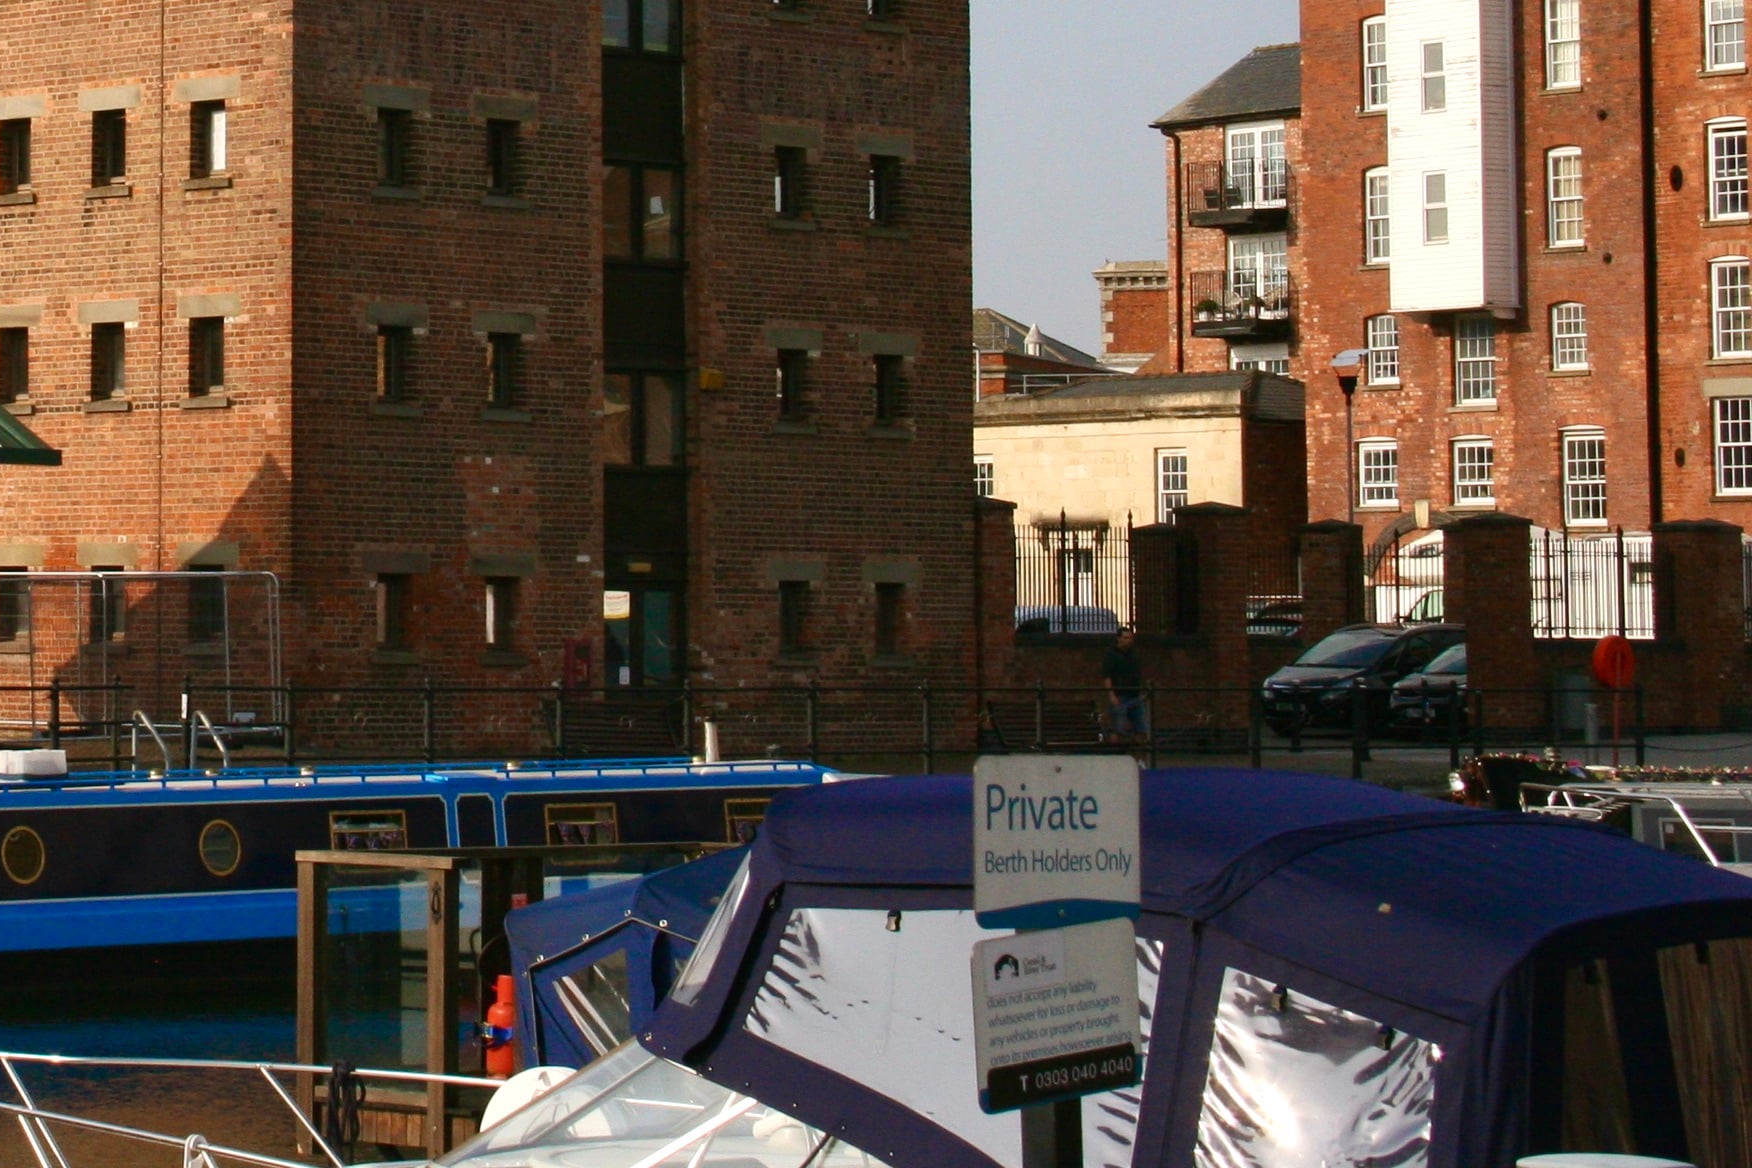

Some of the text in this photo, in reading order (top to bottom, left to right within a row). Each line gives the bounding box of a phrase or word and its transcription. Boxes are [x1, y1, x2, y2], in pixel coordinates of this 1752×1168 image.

[986, 783, 1098, 831] Private
[984, 847, 1131, 877] Berth Holders Only
[1009, 992, 1022, 1004] not
[1111, 995, 1120, 1005] to
[1020, 1056, 1133, 1092] T 0303 040 4040
